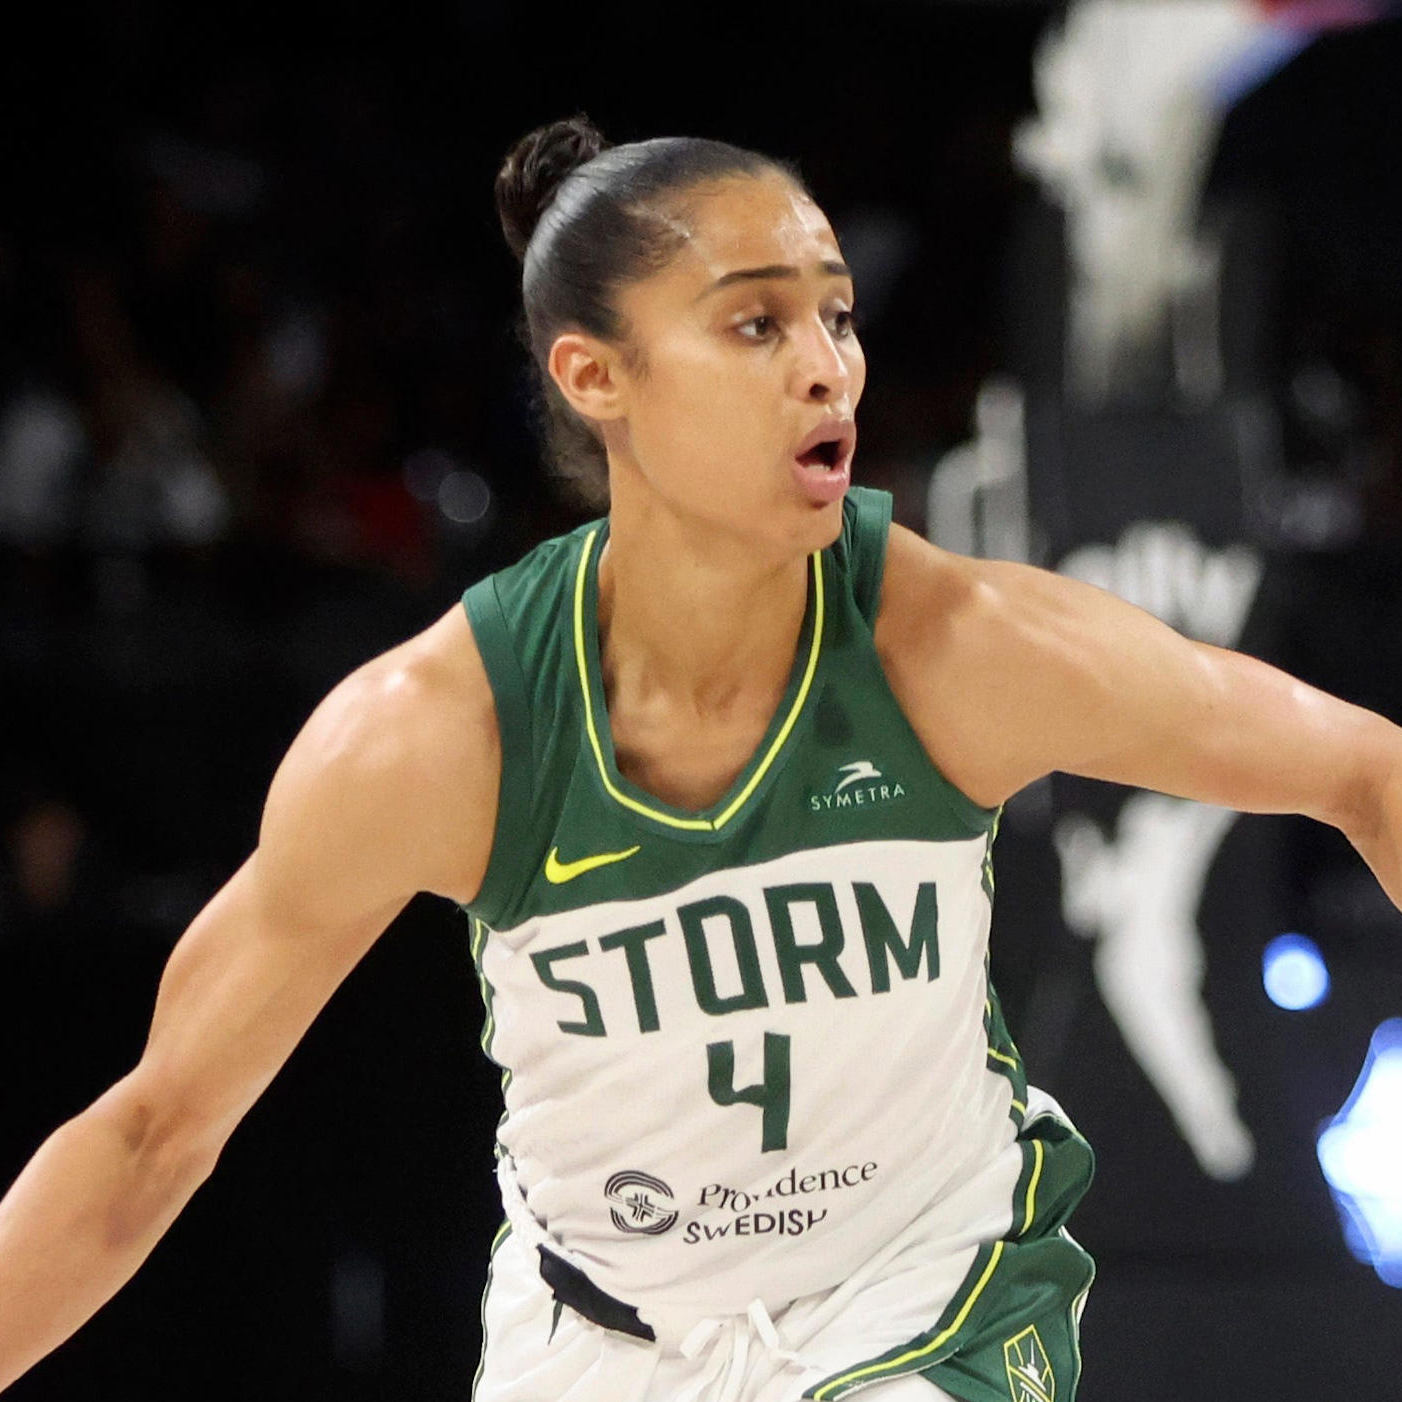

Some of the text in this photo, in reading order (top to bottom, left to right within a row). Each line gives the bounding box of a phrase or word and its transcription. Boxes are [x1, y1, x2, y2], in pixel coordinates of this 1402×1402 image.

[810, 783, 906, 811] SYMETRA
[529, 880, 942, 1038] STORM
[706, 1031, 792, 1153] 4
[697, 1160, 879, 1214] Prodence
